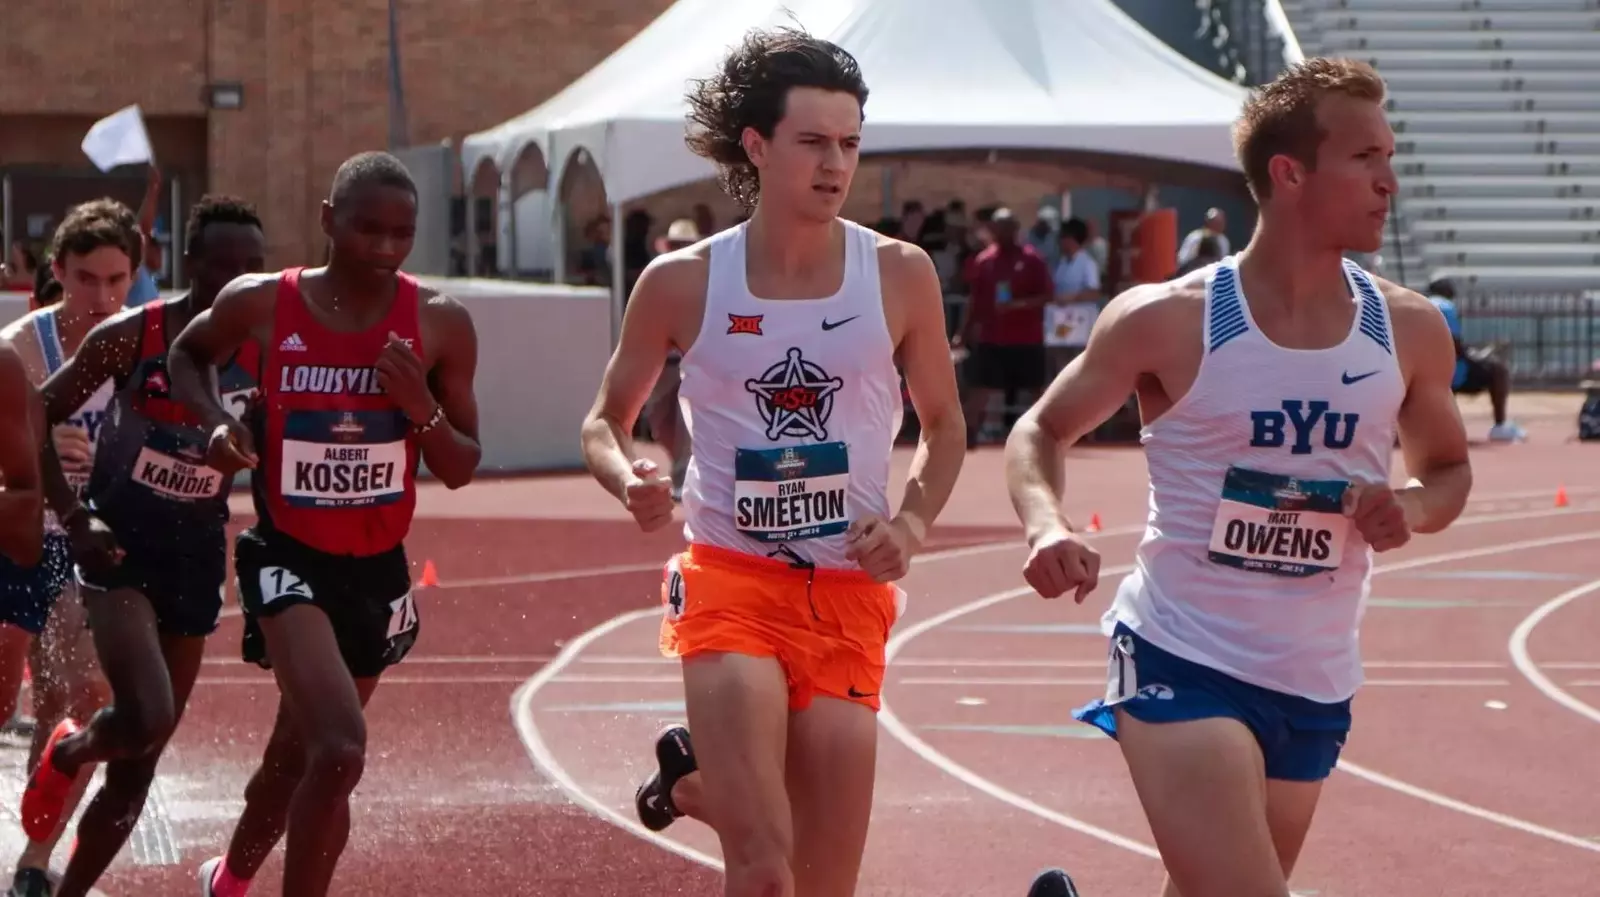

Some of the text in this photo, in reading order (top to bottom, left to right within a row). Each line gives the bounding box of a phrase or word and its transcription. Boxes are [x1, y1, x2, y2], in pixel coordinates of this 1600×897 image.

[280, 365, 390, 394] LOUISVIL
[1250, 400, 1359, 454] BYU
[324, 448, 370, 461] ALBERT
[140, 461, 215, 495] KANDIE
[295, 461, 394, 493] KOSGEI
[778, 481, 806, 496] RYAN
[737, 489, 845, 527] SMEETON
[1267, 513, 1301, 525] MATT
[1224, 519, 1332, 560] OWENS
